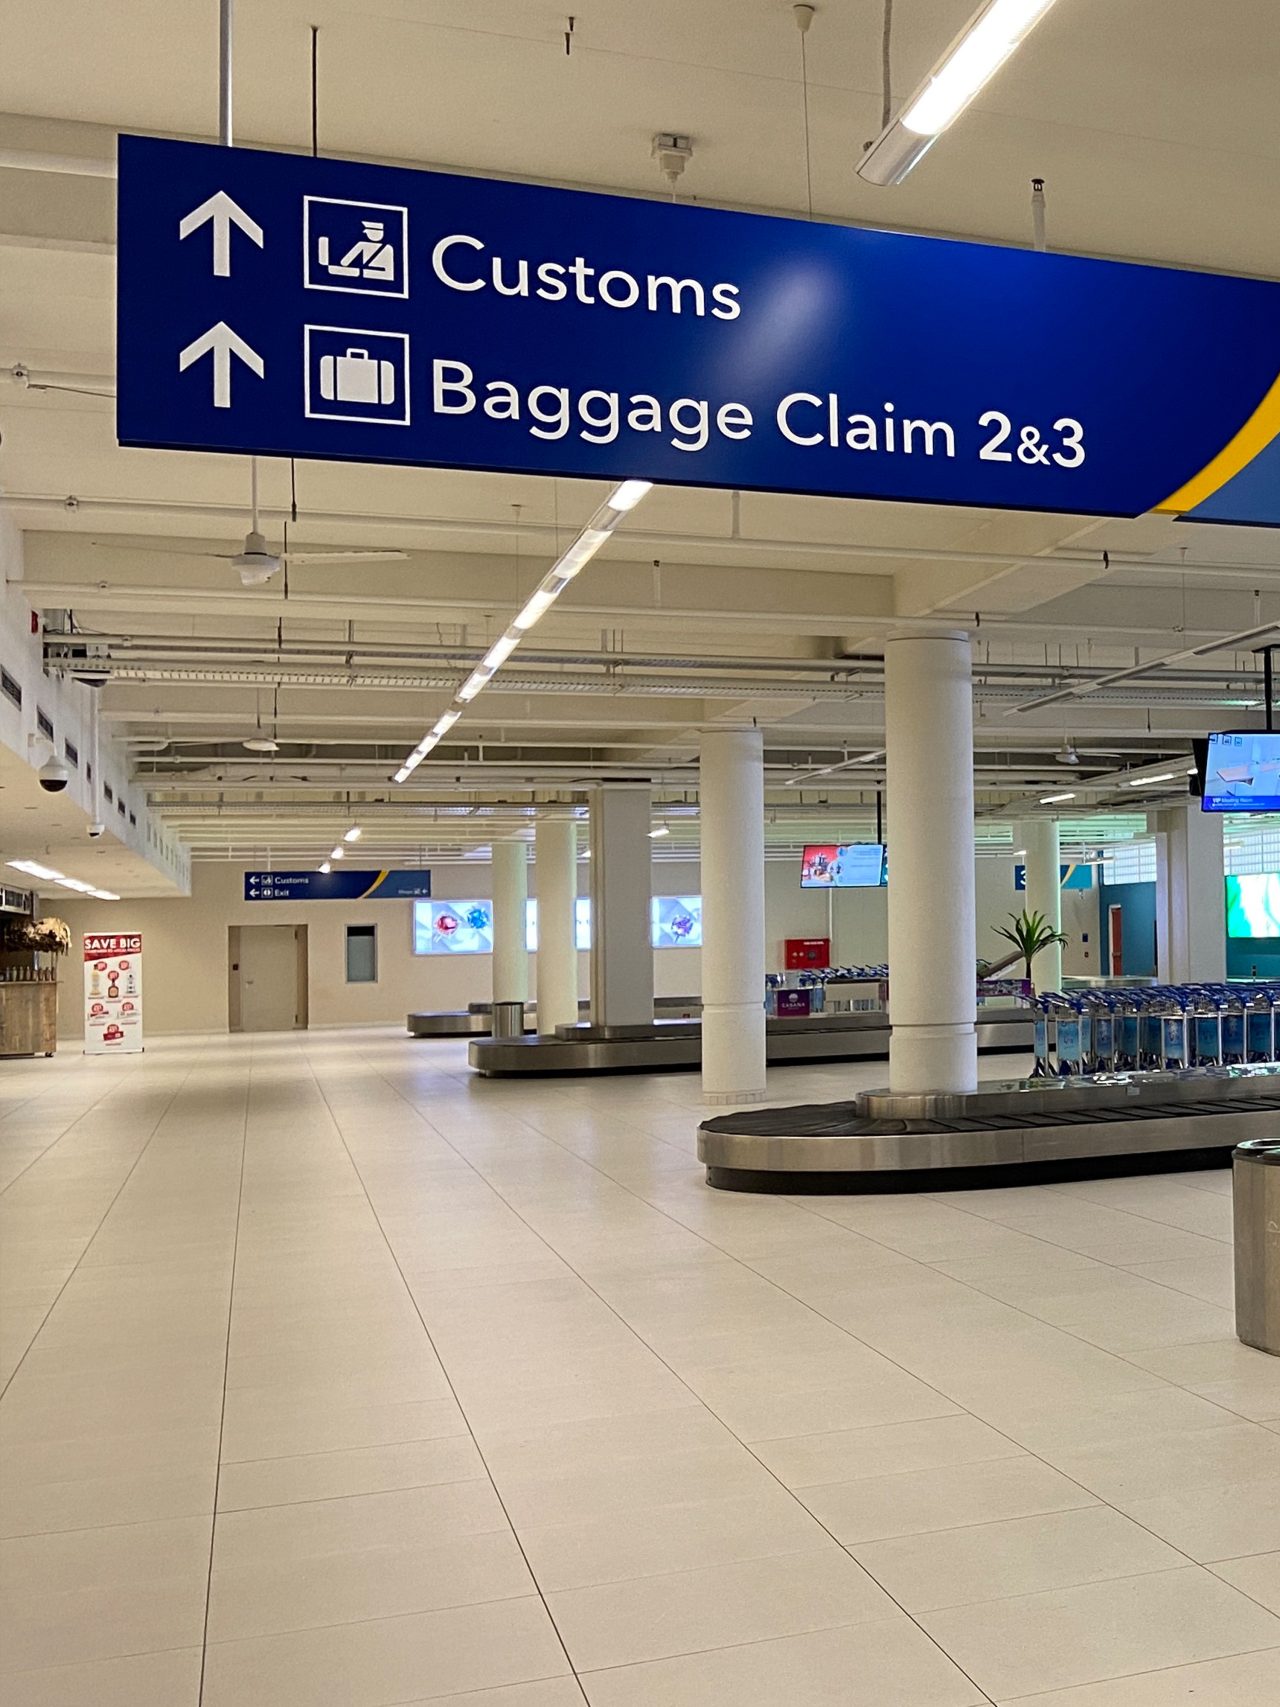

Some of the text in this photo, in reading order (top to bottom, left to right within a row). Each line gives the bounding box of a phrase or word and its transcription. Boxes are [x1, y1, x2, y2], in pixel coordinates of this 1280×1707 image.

[432, 234, 740, 320] Customs
[433, 359, 1086, 468] Baggage Claim 2&3
[274, 889, 290, 897] Exit
[84, 938, 140, 950] SAVE BIG
